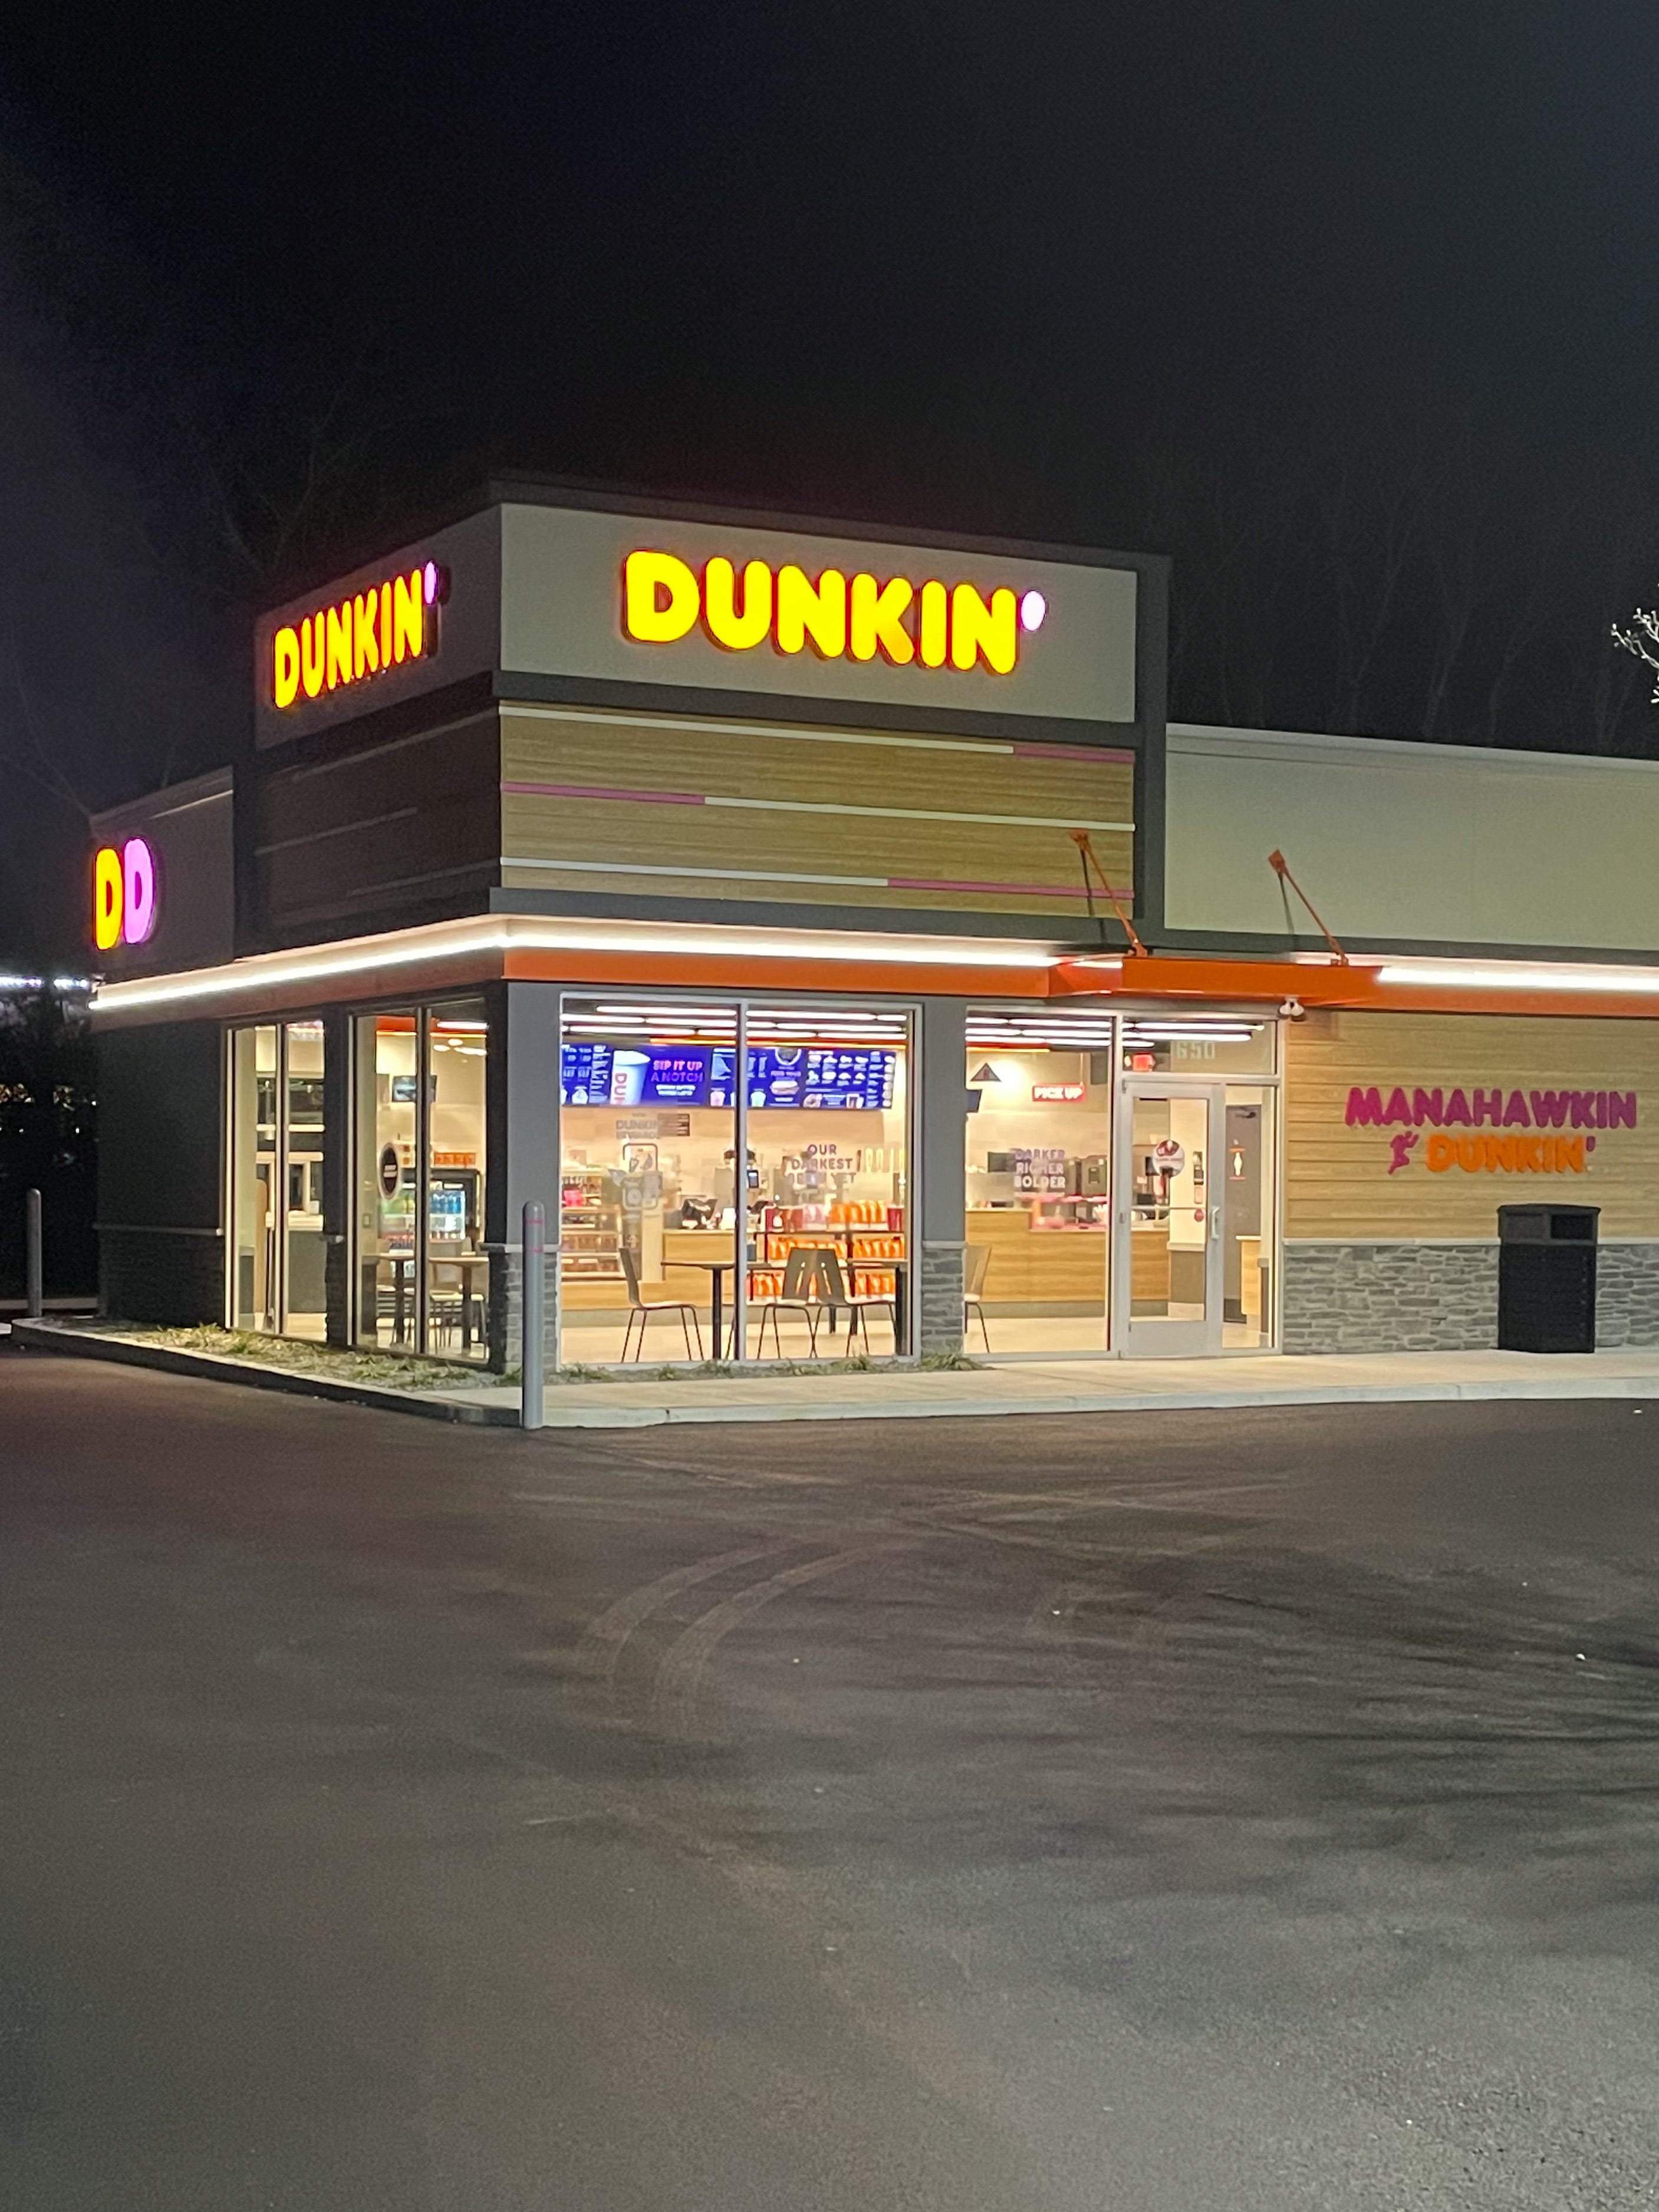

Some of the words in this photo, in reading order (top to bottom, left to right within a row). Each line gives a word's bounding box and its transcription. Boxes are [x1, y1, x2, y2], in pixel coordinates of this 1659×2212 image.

[623, 548, 1047, 676] DUNKIN'
[273, 560, 438, 708] DUNKIN'
[653, 1060, 672, 1071] SIP
[673, 1061, 685, 1071] IT
[687, 1061, 703, 1071] UP
[650, 1071, 660, 1082] A
[661, 1072, 703, 1083] NOTCH
[1034, 1087, 1064, 1100] PICK
[1064, 1087, 1082, 1100] UP
[1345, 1087, 1637, 1128] MANAHAWKIN
[807, 1144, 837, 1156] OUR
[1426, 1134, 1597, 1173] DUNKIN'
[791, 1158, 853, 1170] DARKEST
